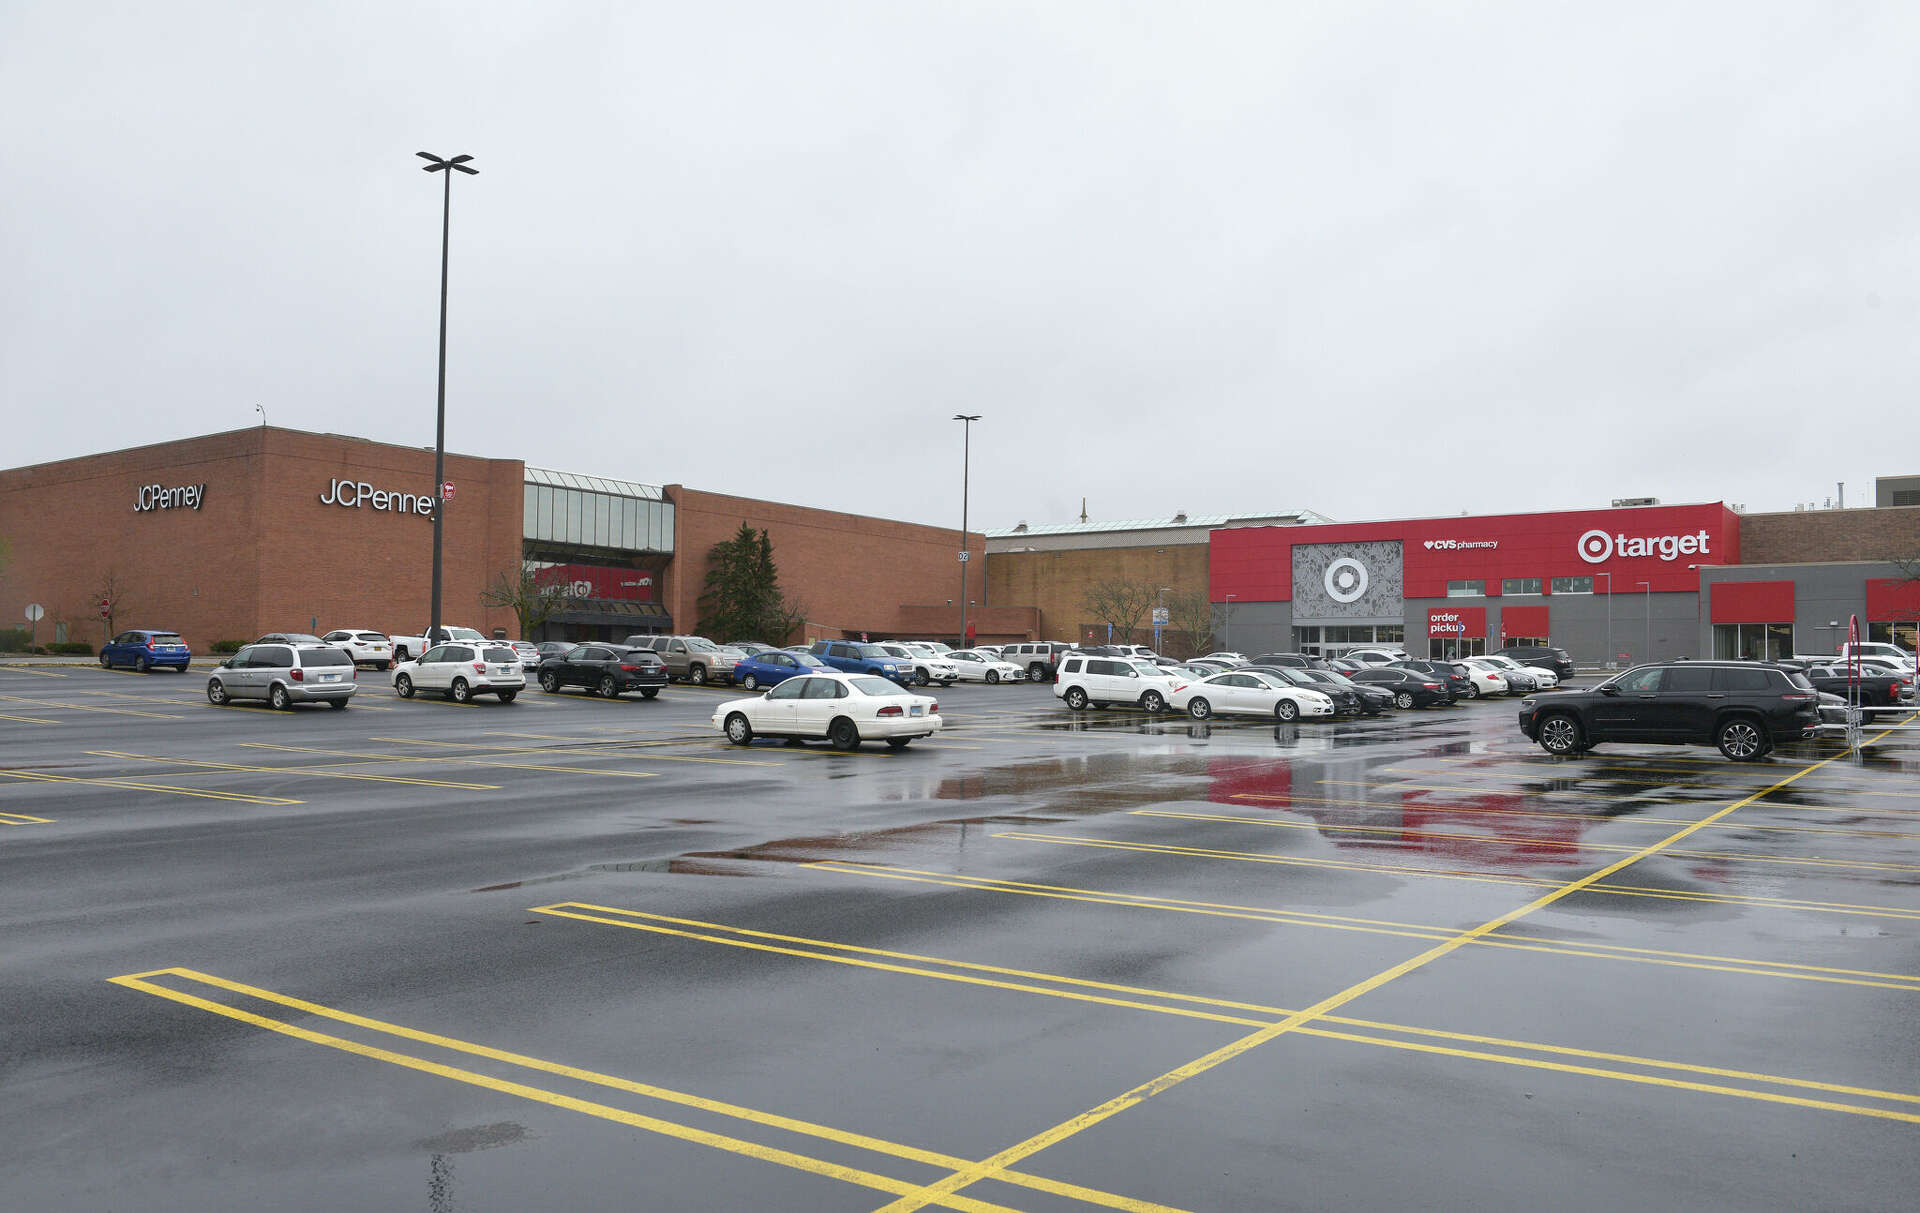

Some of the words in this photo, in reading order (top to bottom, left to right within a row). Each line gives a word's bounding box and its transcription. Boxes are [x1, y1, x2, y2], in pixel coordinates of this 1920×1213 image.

[133, 484, 204, 512] JCPenney
[1434, 539, 1457, 550] CVS
[1457, 540, 1498, 551] pharmacy
[1615, 530, 1710, 561] target
[1430, 613, 1459, 622] order
